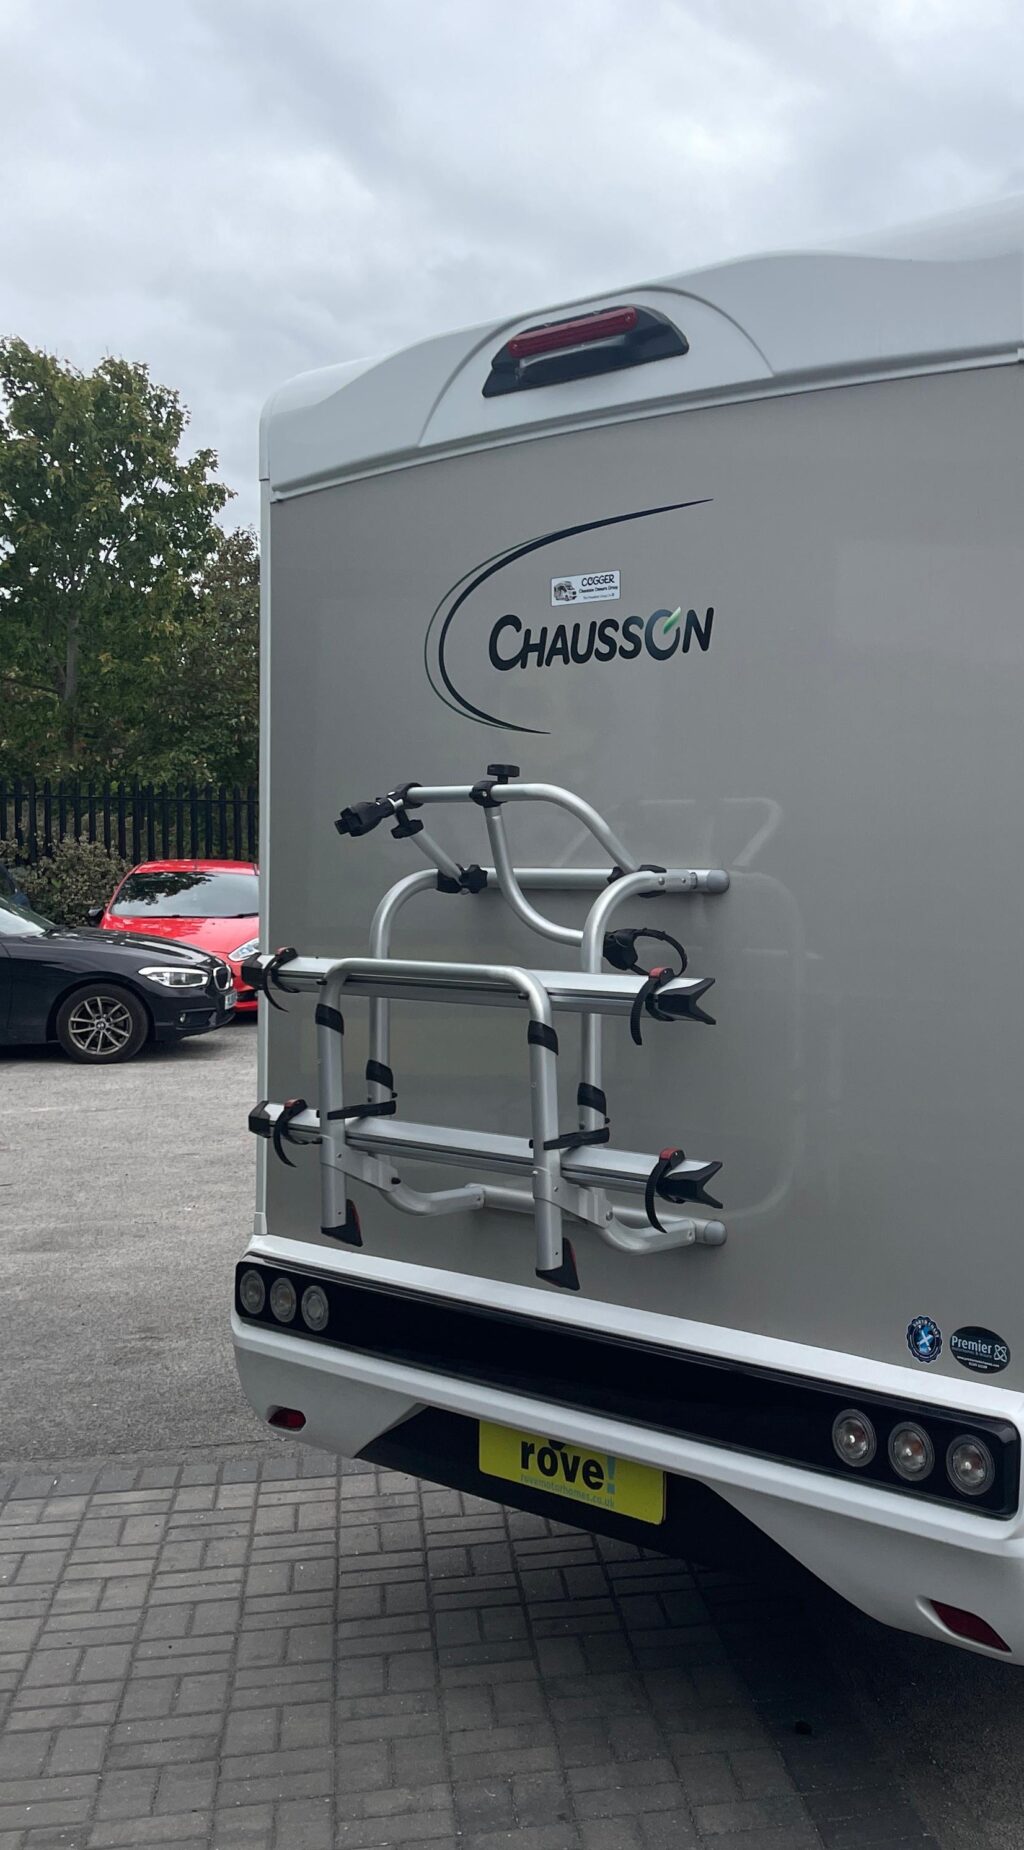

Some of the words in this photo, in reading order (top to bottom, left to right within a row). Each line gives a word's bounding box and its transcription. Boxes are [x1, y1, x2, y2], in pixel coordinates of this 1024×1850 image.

[581, 574, 615, 587] COGGER
[488, 606, 715, 671] CHAUSSON
[951, 1335, 992, 1355] Premier
